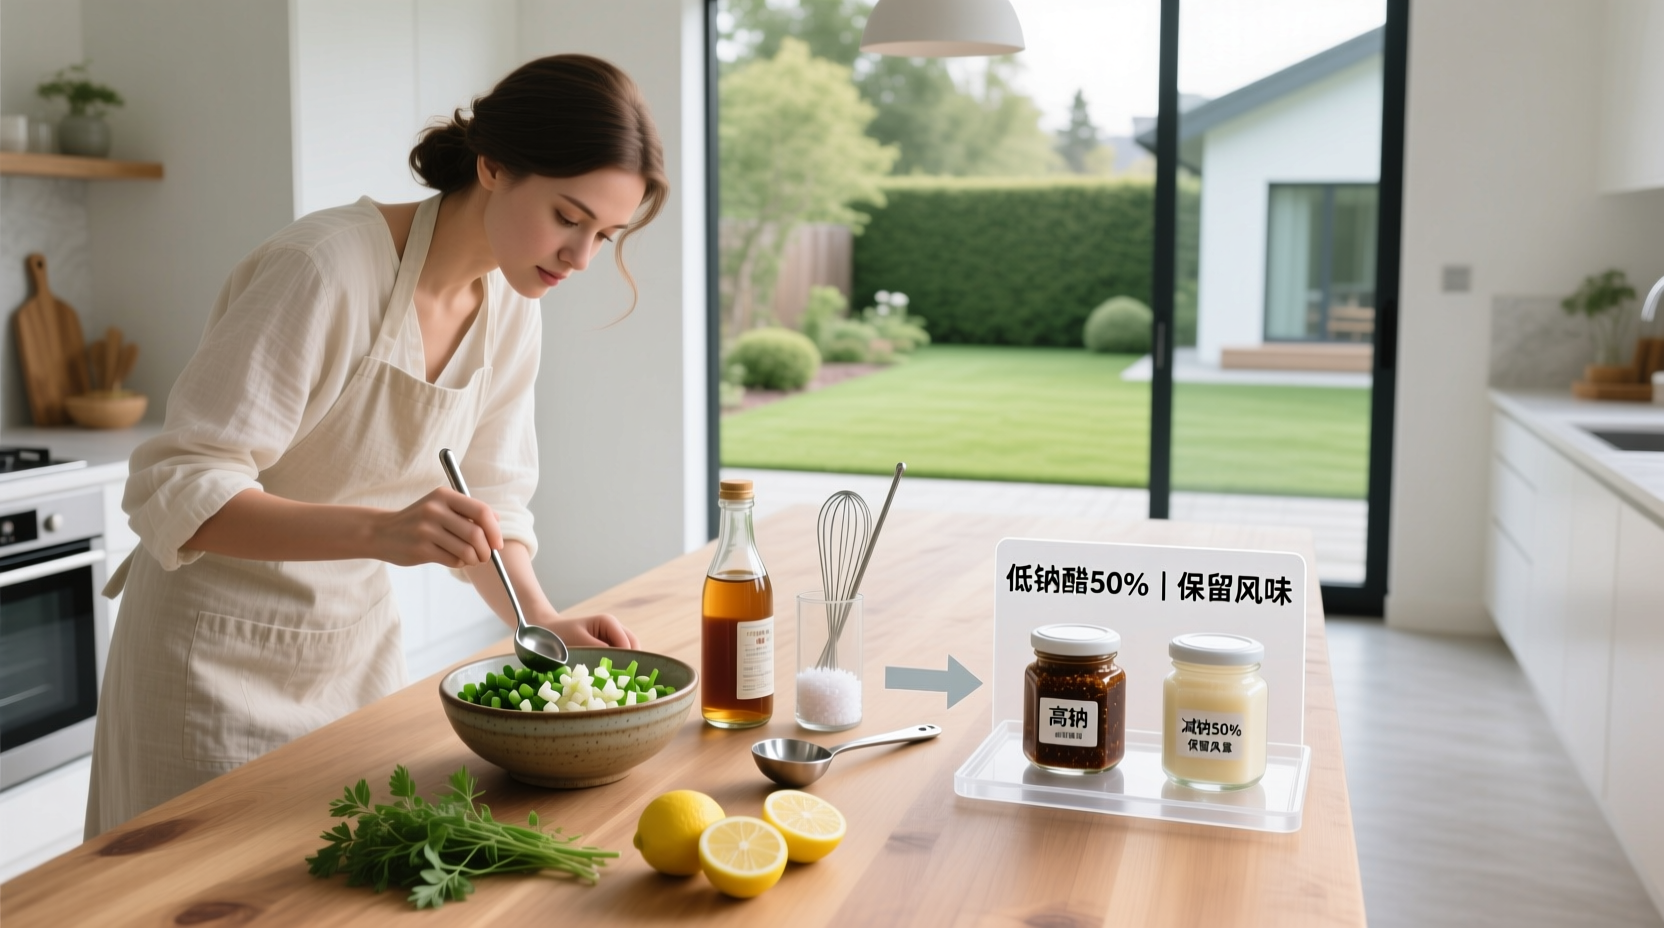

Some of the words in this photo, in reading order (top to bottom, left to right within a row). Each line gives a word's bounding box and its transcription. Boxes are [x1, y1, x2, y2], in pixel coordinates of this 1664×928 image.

[1005, 563, 1149, 597] 低钠醋50%
[1177, 571, 1293, 607] 保留风味
[1048, 705, 1088, 729] 高钠
